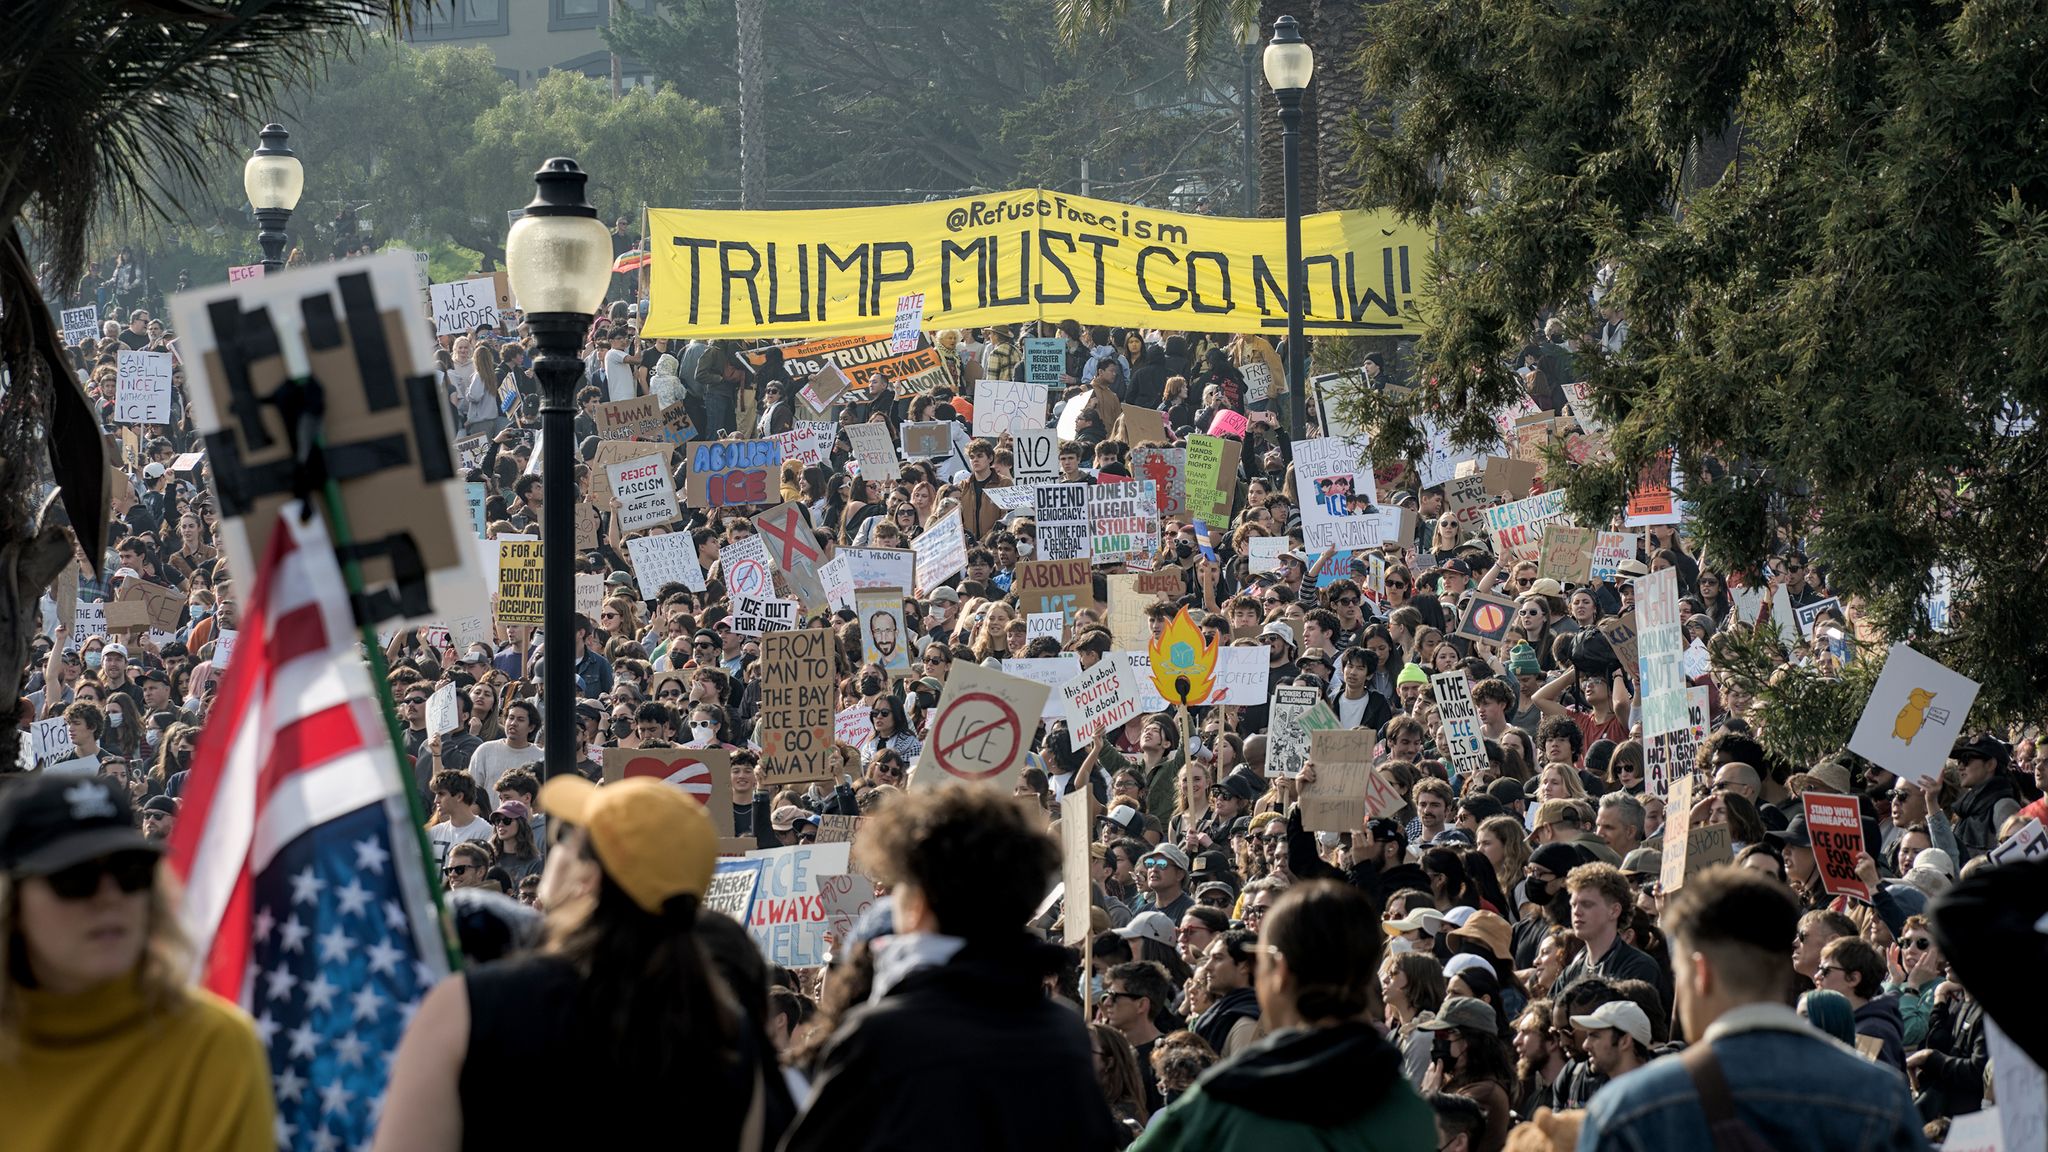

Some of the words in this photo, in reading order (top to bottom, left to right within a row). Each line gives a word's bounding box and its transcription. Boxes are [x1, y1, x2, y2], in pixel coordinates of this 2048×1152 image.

[231, 267, 255, 282] ICE
[673, 236, 914, 325] TRUMP
[941, 229, 1119, 312] MUST
[1137, 245, 1236, 315] GO
[1253, 245, 1412, 322] NOW!
[450, 282, 468, 297] IT
[444, 294, 476, 311] WAS
[897, 293, 924, 311] HATE
[63, 308, 95, 323] DEFEND
[438, 306, 499, 333] MURDER
[895, 311, 920, 322] DOESN'T
[894, 321, 910, 331] MAKE
[892, 330, 920, 341] AMERICA
[891, 339, 918, 352] GREAT
[1031, 364, 1047, 372] PEACE
[1049, 364, 1061, 372] AND
[1032, 355, 1059, 363] REGISTER
[120, 366, 168, 378] SPELL
[851, 352, 936, 385] REGIME
[121, 378, 165, 392] INCEL
[1254, 375, 1272, 387] THE
[979, 381, 1048, 404] STAND
[120, 405, 157, 420] ICE
[604, 404, 652, 426] HUMAN
[993, 400, 1028, 418] FOR
[783, 443, 798, 454] LA
[1017, 435, 1050, 469] NO
[1189, 447, 1213, 455] HANDS
[1191, 439, 1213, 447] SMALL
[1294, 438, 1342, 465] THIS
[693, 441, 781, 474] ABOLISH
[858, 451, 894, 465] AMERICA
[1187, 460, 1212, 469] RIGHTS
[1189, 453, 1202, 461] OFF
[1203, 455, 1218, 463] OUR
[620, 464, 659, 481] REJECT
[1299, 460, 1328, 478] THE
[618, 477, 664, 496] FASCISM
[706, 469, 767, 508] ICE
[1096, 483, 1121, 501] ONE
[1124, 481, 1137, 498] IS
[628, 500, 647, 511] CARE
[651, 498, 666, 507] FOR
[1037, 486, 1085, 508] DEFEND
[1325, 494, 1348, 516] ICE
[623, 512, 643, 524] EACH
[646, 509, 672, 520] OTHER
[1037, 508, 1087, 522] DEMOCRACY:
[1091, 500, 1136, 519] LLEGAL
[1489, 504, 1518, 530] ICE
[1038, 526, 1053, 539] IT'S
[1053, 526, 1070, 538] TIME
[1071, 525, 1087, 538] FOR
[1097, 517, 1146, 536] STOLEN
[1305, 522, 1333, 549] WE
[1335, 519, 1379, 546] WANT
[637, 533, 689, 554] SUPER
[1043, 540, 1049, 552] A
[1050, 538, 1082, 551] GENERAL
[1094, 534, 1130, 554] LAND
[1498, 525, 1527, 549] NOT
[501, 545, 508, 558] $
[511, 544, 530, 558] FOR
[843, 549, 863, 558] THE
[869, 551, 901, 561] WRONG
[523, 558, 536, 568] AND
[500, 568, 544, 583] EDUCATI
[1022, 561, 1092, 589] ABOLISH
[1140, 574, 1180, 592] HUELGA
[501, 583, 521, 598] NOT
[76, 609, 91, 619] THE
[499, 600, 544, 614] OCCUPATI
[740, 596, 761, 616] ICE
[765, 602, 791, 618] OUT
[92, 624, 107, 632] THE
[735, 617, 755, 631] FOR
[1028, 618, 1044, 632] NO
[1045, 617, 1062, 631] ONE
[764, 631, 826, 660] FROM
[764, 663, 798, 684] MN
[803, 658, 828, 683] TO
[1064, 683, 1080, 699] this
[1096, 661, 1117, 682] about
[1225, 671, 1266, 685] OFFICE
[763, 688, 793, 706] THE
[800, 685, 829, 706] BAY
[1075, 676, 1120, 708] POLITICS
[1436, 677, 1466, 701] THE
[1085, 705, 1094, 719] its
[1096, 690, 1120, 713] about
[1440, 701, 1474, 719] WRONG
[764, 710, 796, 730] ICE
[798, 708, 829, 727] ICE
[1077, 698, 1136, 742] HUMANITY
[1450, 719, 1474, 737] ICE
[784, 730, 812, 751] GO
[949, 715, 1006, 764] ICE
[1451, 739, 1466, 755] IS
[1454, 754, 1490, 773] MELTING
[1810, 804, 1834, 815] STAND
[1834, 807, 1853, 817] WITH
[821, 815, 849, 829] WHEN
[1809, 814, 1858, 828] MINNEAPOLIS
[1811, 830, 1832, 849] ICE
[1834, 833, 1861, 851] OUT
[1826, 849, 1853, 866] FOR
[755, 850, 812, 899] ICE
[1826, 863, 1862, 882] GOO
[706, 874, 752, 896] ENERAL
